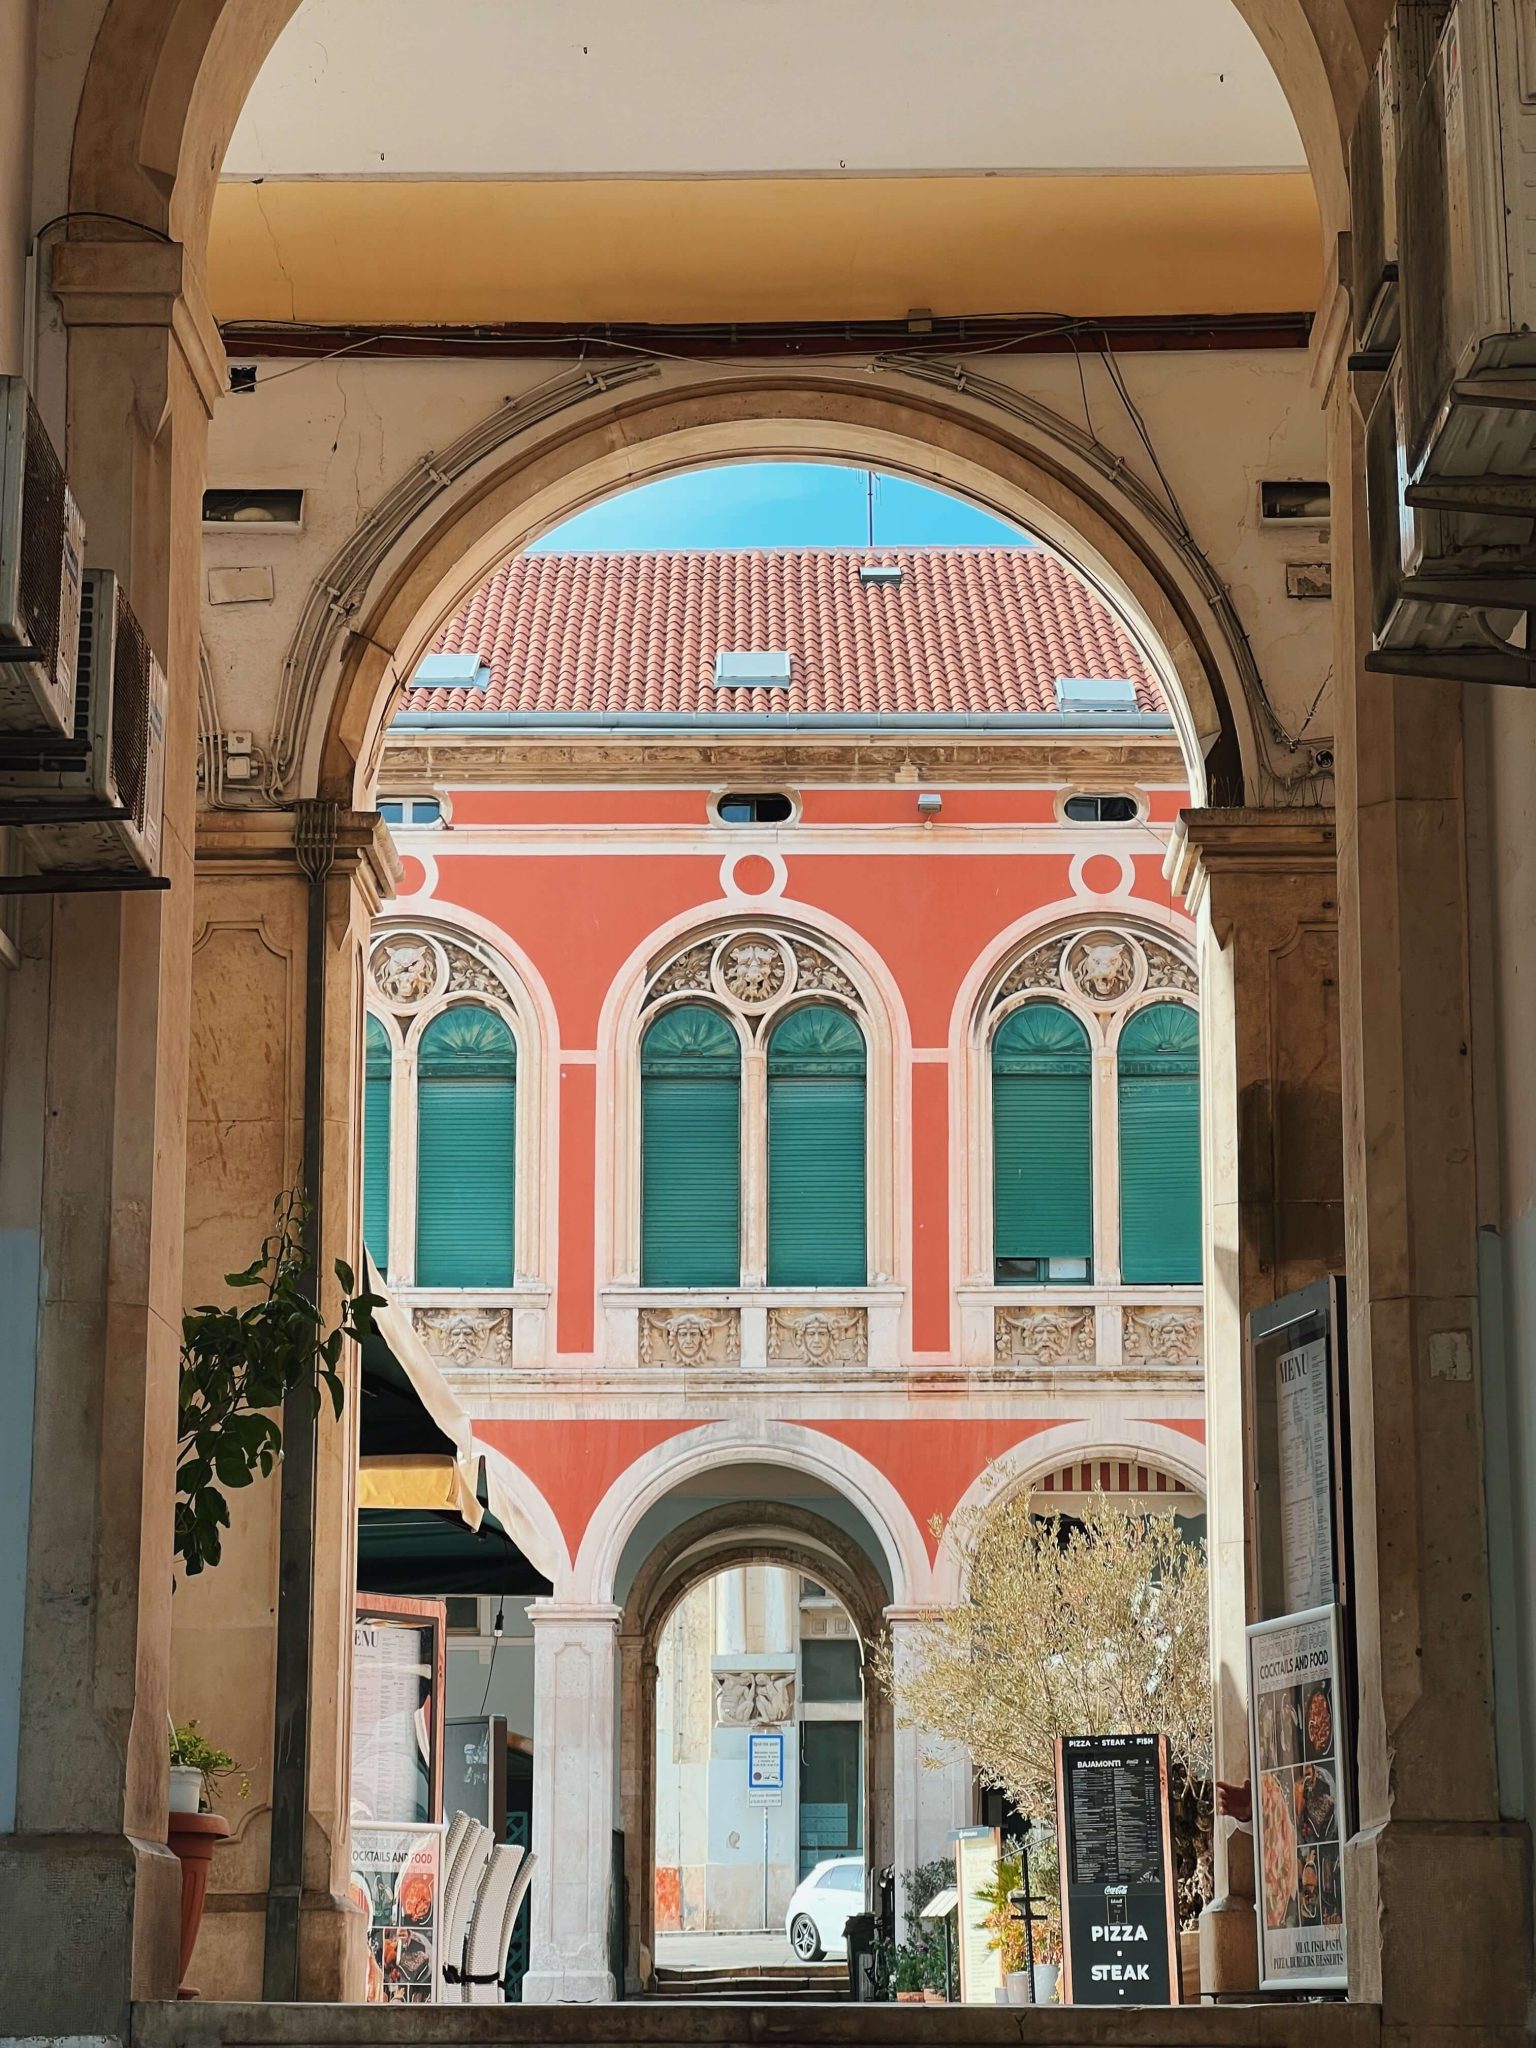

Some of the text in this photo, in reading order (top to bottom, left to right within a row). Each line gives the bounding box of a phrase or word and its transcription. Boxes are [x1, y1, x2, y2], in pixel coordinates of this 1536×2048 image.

[1280, 1351, 1308, 1384] MENU
[354, 1629, 379, 1648] ENU
[1260, 1649, 1328, 1680] COCKTAILS AND FOOD
[1101, 1739, 1126, 1747] STEAK
[1136, 1737, 1154, 1745] FISH
[1077, 1760, 1121, 1768] BAJAMONTI
[352, 1850, 391, 1862] OCKTAILS
[411, 1853, 432, 1864] OOD
[1091, 1925, 1148, 1942] PIZZA
[1091, 1964, 1150, 1981] STEAK
